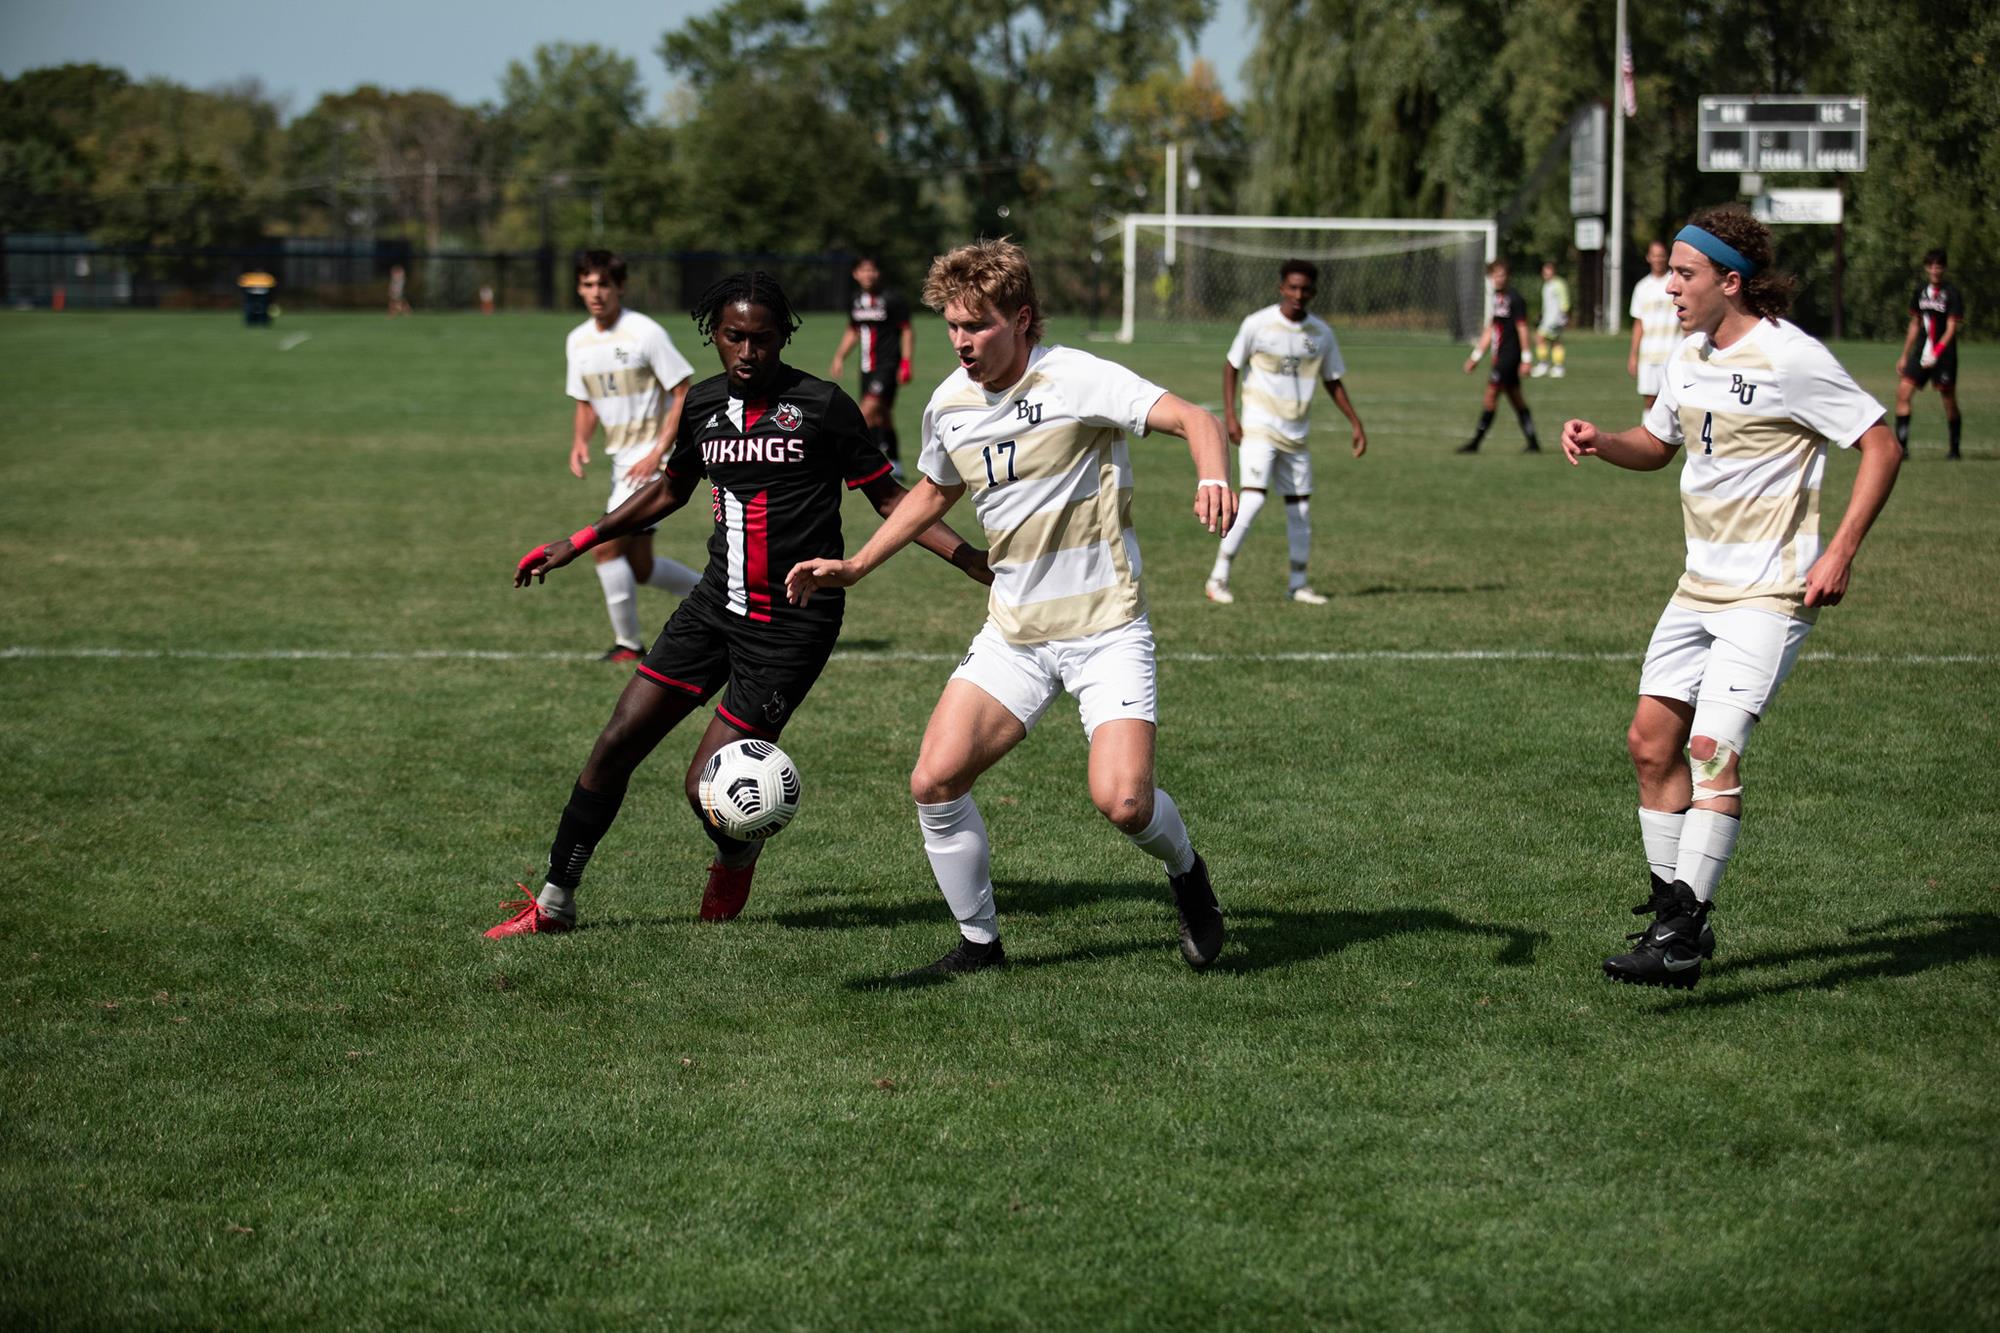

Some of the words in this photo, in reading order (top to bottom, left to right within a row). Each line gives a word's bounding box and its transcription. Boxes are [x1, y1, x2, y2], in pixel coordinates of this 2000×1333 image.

[1730, 373, 1757, 405] BU
[1015, 399, 1043, 425] BU
[1700, 411, 1713, 455] 4
[701, 437, 804, 464] VIKINGS
[982, 440, 1020, 488] 17
